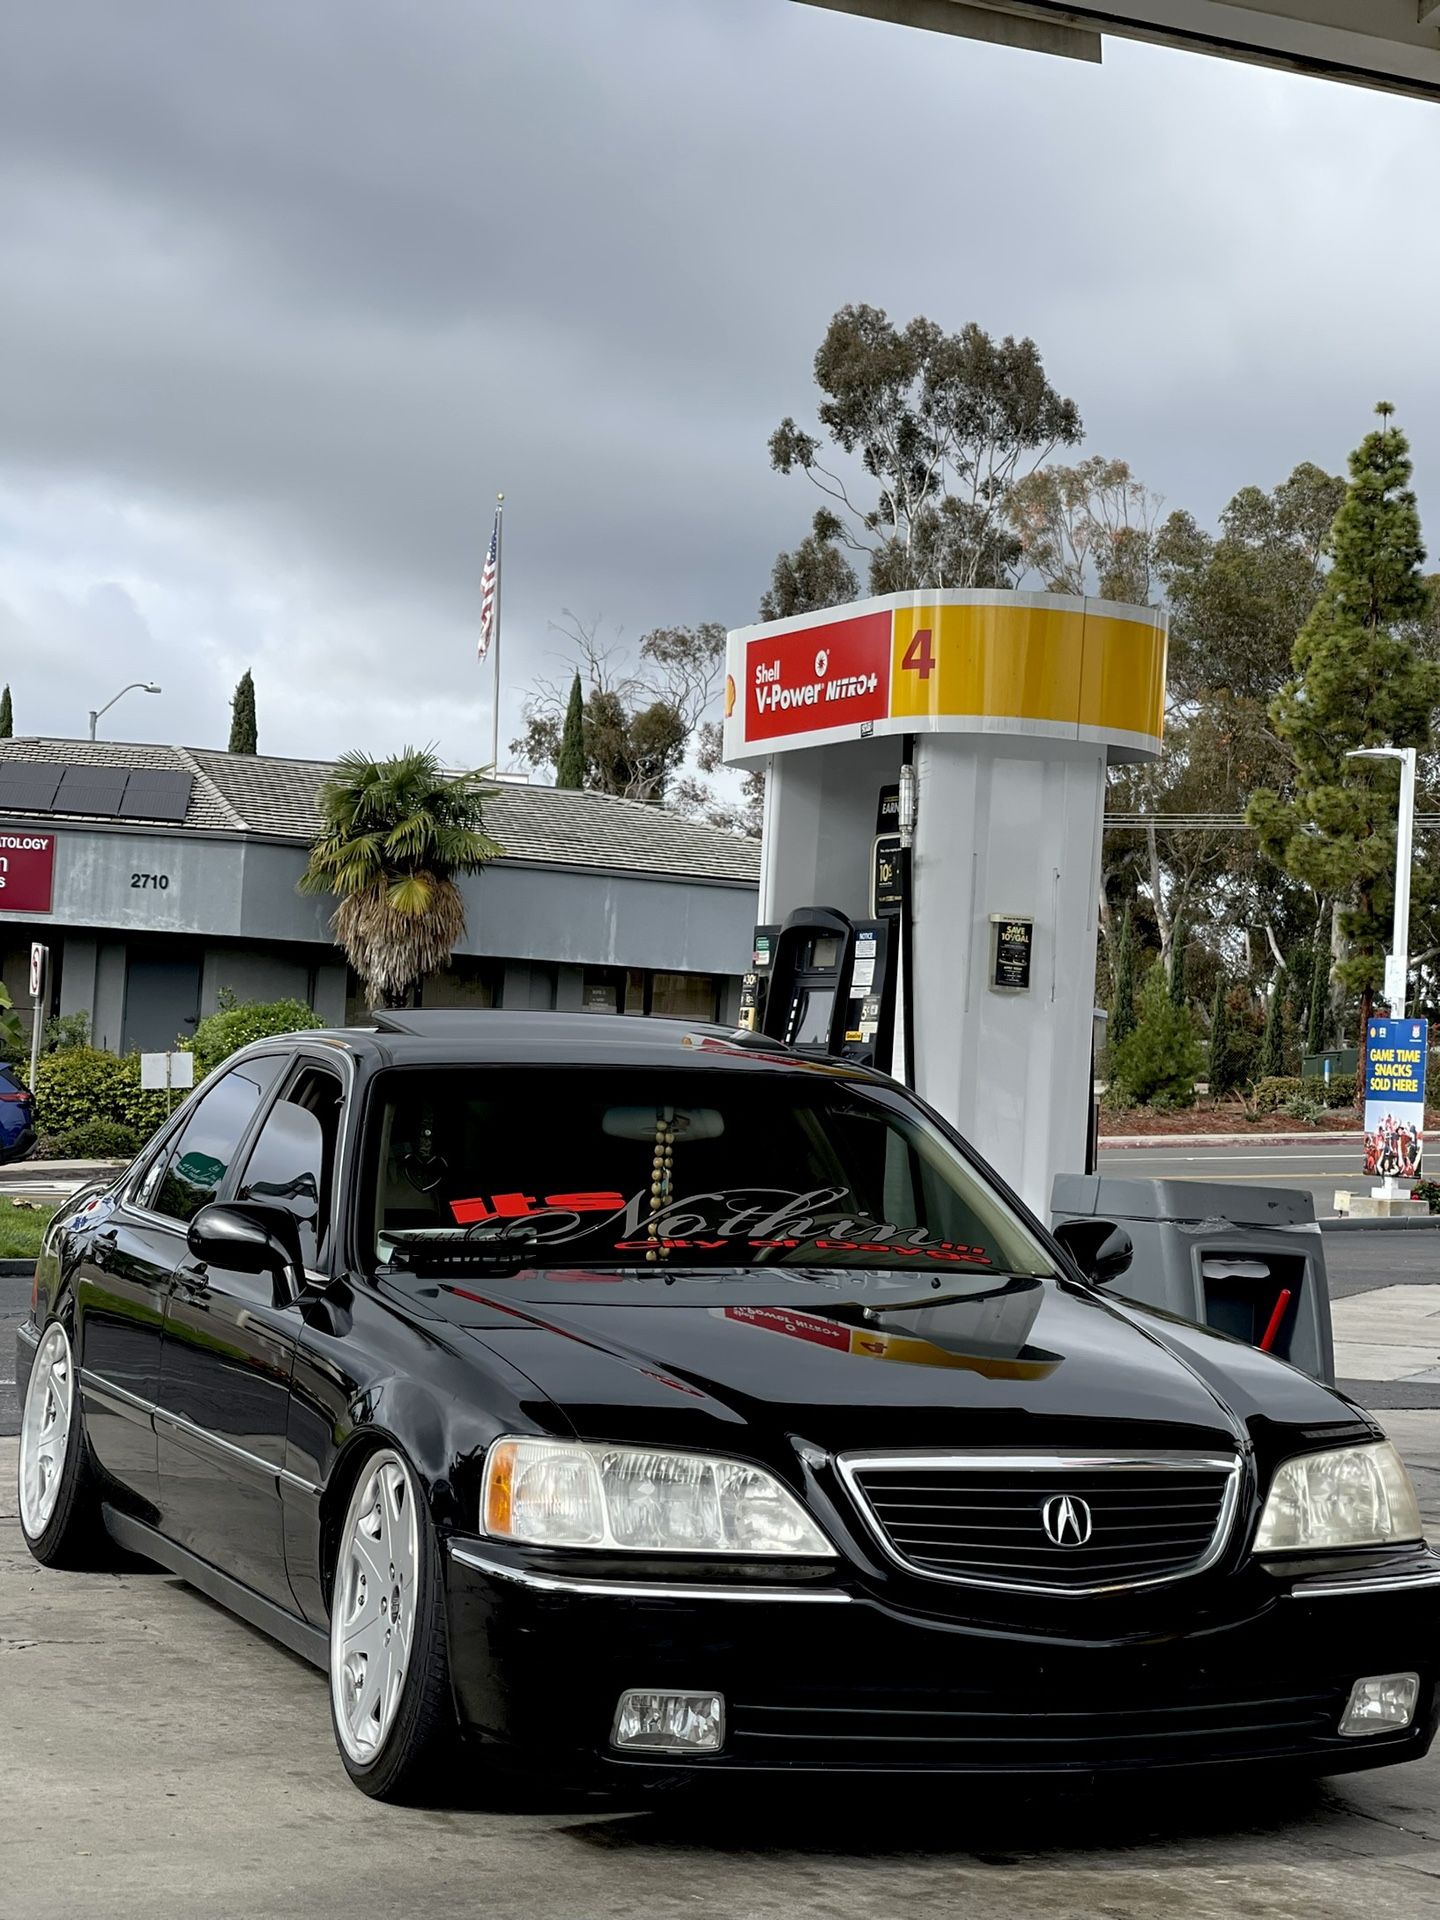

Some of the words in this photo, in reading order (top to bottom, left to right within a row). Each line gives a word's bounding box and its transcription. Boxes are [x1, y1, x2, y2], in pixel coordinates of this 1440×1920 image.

[902, 629, 936, 679] 4
[755, 660, 781, 685] Shell
[755, 681, 822, 714] V-Power
[0, 836, 48, 851] TOLOGY
[130, 874, 169, 890] 2710
[1370, 1048, 1394, 1062] GAME
[1396, 1049, 1421, 1063] TIME
[1374, 1063, 1412, 1077] SNACKS
[1370, 1078, 1391, 1091] SOLD
[1392, 1078, 1418, 1092] HERE
